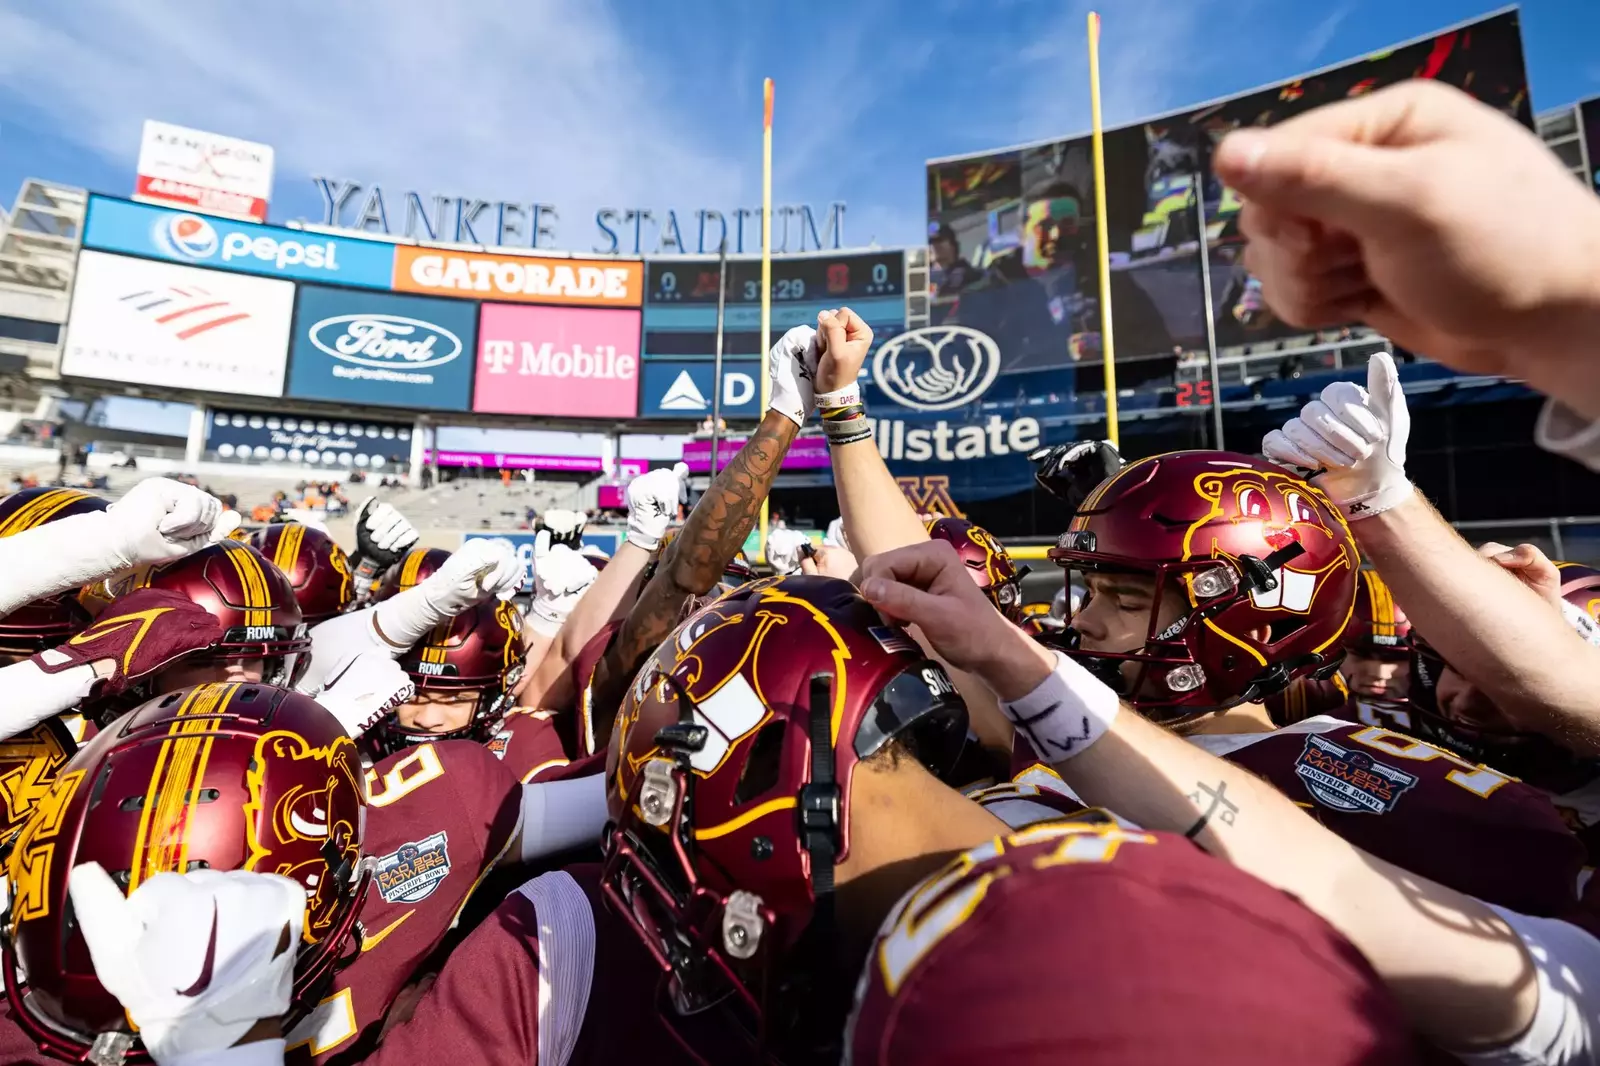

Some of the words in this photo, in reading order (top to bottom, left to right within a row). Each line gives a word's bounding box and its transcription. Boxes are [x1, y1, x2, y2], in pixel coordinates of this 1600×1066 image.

[312, 176, 560, 251] YANKEE
[593, 202, 848, 256] STADIUM
[222, 230, 339, 271] pepsi
[409, 254, 631, 299] GATORADE
[744, 278, 806, 300] 3:29
[334, 320, 440, 363] Ford
[518, 341, 637, 381] Mobile
[1176, 381, 1213, 408] 25
[867, 415, 1041, 462] llstate
[246, 625, 275, 640] ROW
[418, 662, 445, 676] ROW
[1301, 765, 1349, 793] PINSTRIPE
[1351, 786, 1382, 812] BOWL
[1304, 754, 1392, 801] MOWERS
[1310, 747, 1349, 771] BAD
[1354, 768, 1397, 790] BOY
[379, 863, 409, 882] BAD
[413, 848, 441, 868] BOY
[381, 855, 445, 890] MOWERS
[387, 876, 423, 900] PINSTRIPE
[424, 867, 446, 880] BOWL
